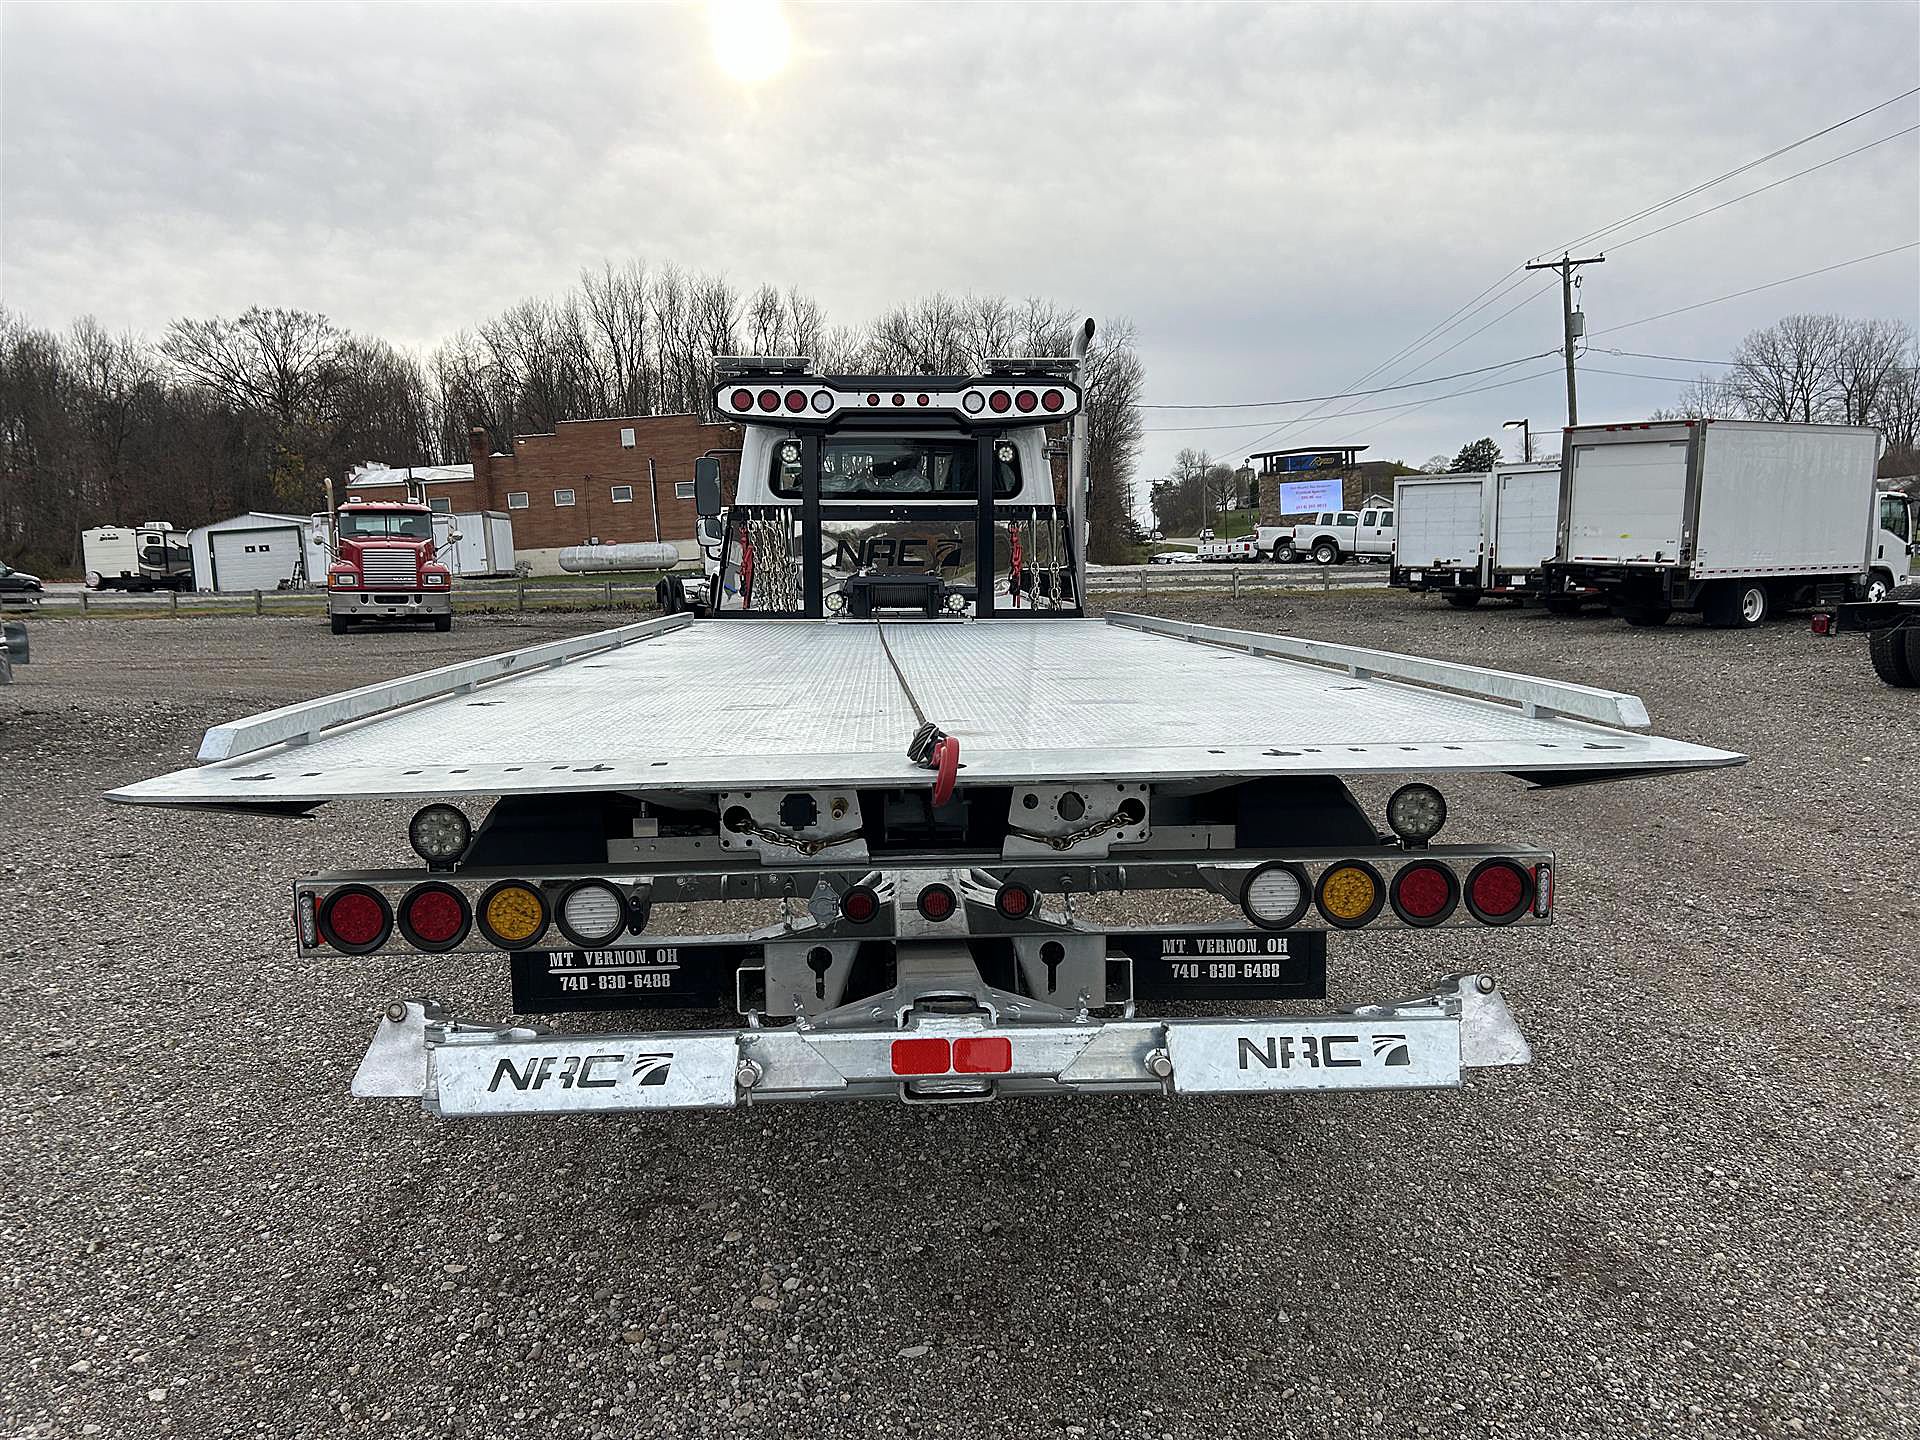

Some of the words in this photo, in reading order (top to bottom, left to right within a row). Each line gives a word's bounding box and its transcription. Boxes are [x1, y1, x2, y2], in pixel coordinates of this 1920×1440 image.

[836, 540, 928, 566] NRC
[1162, 938, 1189, 954] MT.
[1267, 938, 1288, 952] OH
[549, 952, 577, 967] MT.
[656, 948, 678, 963] OH
[1171, 963, 1280, 979] 740-830-6488
[560, 973, 671, 991] 740-830-6488
[1237, 1035, 1362, 1070] NRC
[487, 1054, 625, 1093] NRC
